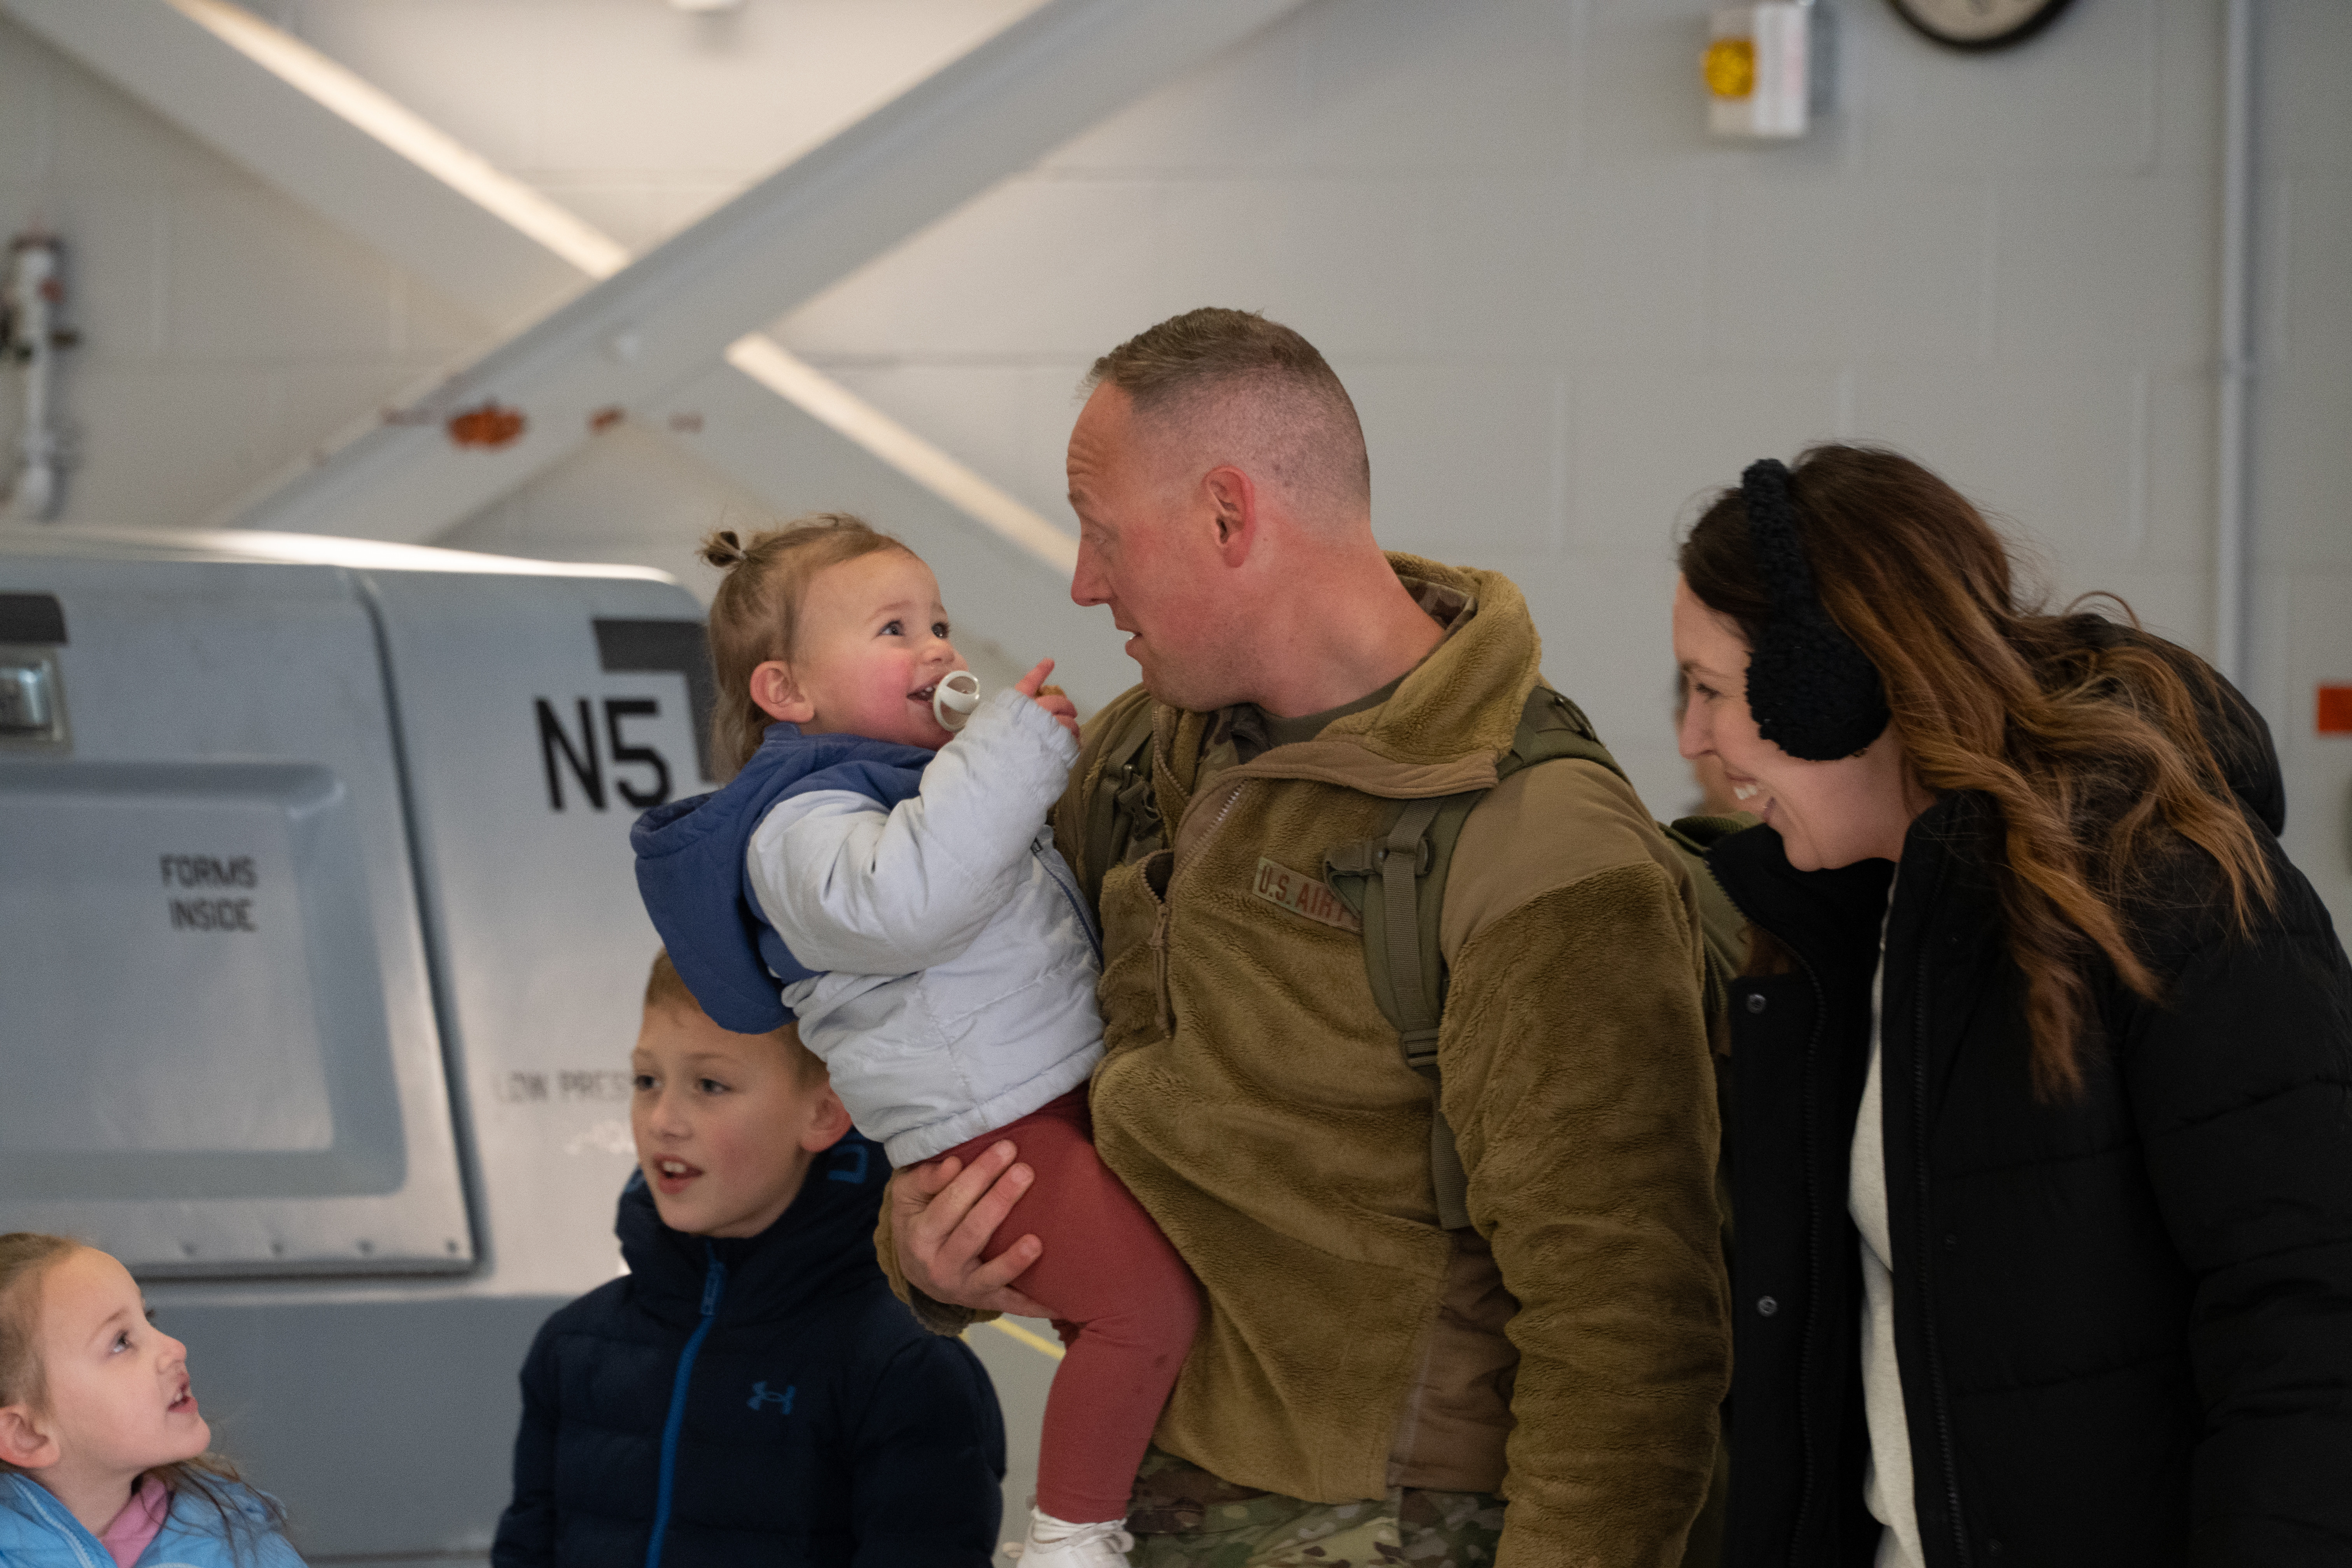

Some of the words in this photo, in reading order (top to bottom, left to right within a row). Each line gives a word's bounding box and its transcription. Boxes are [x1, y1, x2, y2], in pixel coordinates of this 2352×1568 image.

[160, 855, 257, 888] FORMS
[1258, 865, 1290, 905] U.S.
[170, 898, 257, 931] INSIDE
